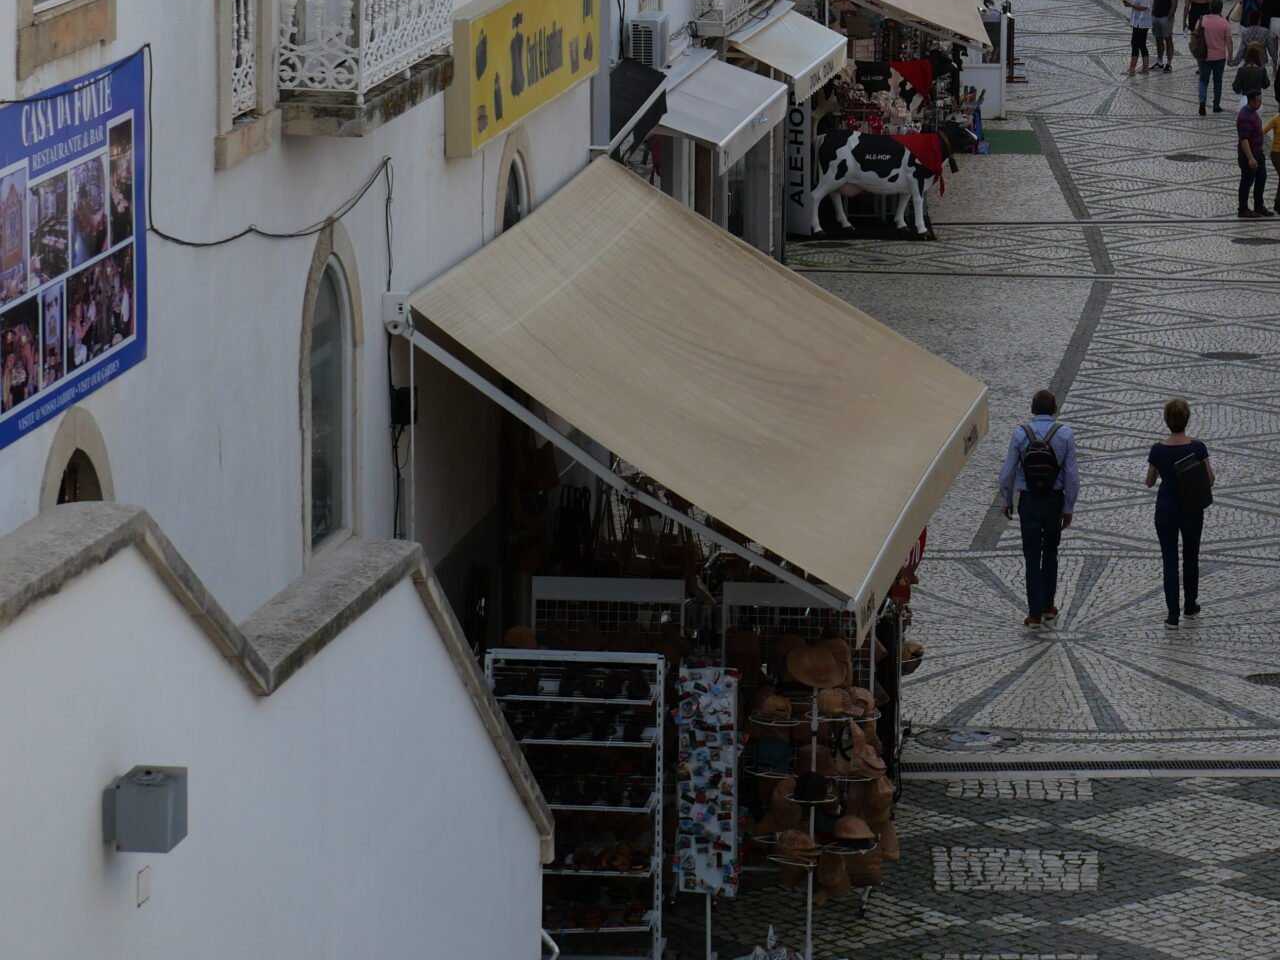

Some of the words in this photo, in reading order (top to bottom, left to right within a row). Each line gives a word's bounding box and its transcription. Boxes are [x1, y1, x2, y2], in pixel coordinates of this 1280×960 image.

[22, 99, 55, 147] CASA
[57, 94, 71, 129] DA
[74, 71, 113, 126] FONTE
[32, 134, 82, 171] RESTAURANTE
[83, 131, 89, 148] &
[90, 125, 104, 145] BAR
